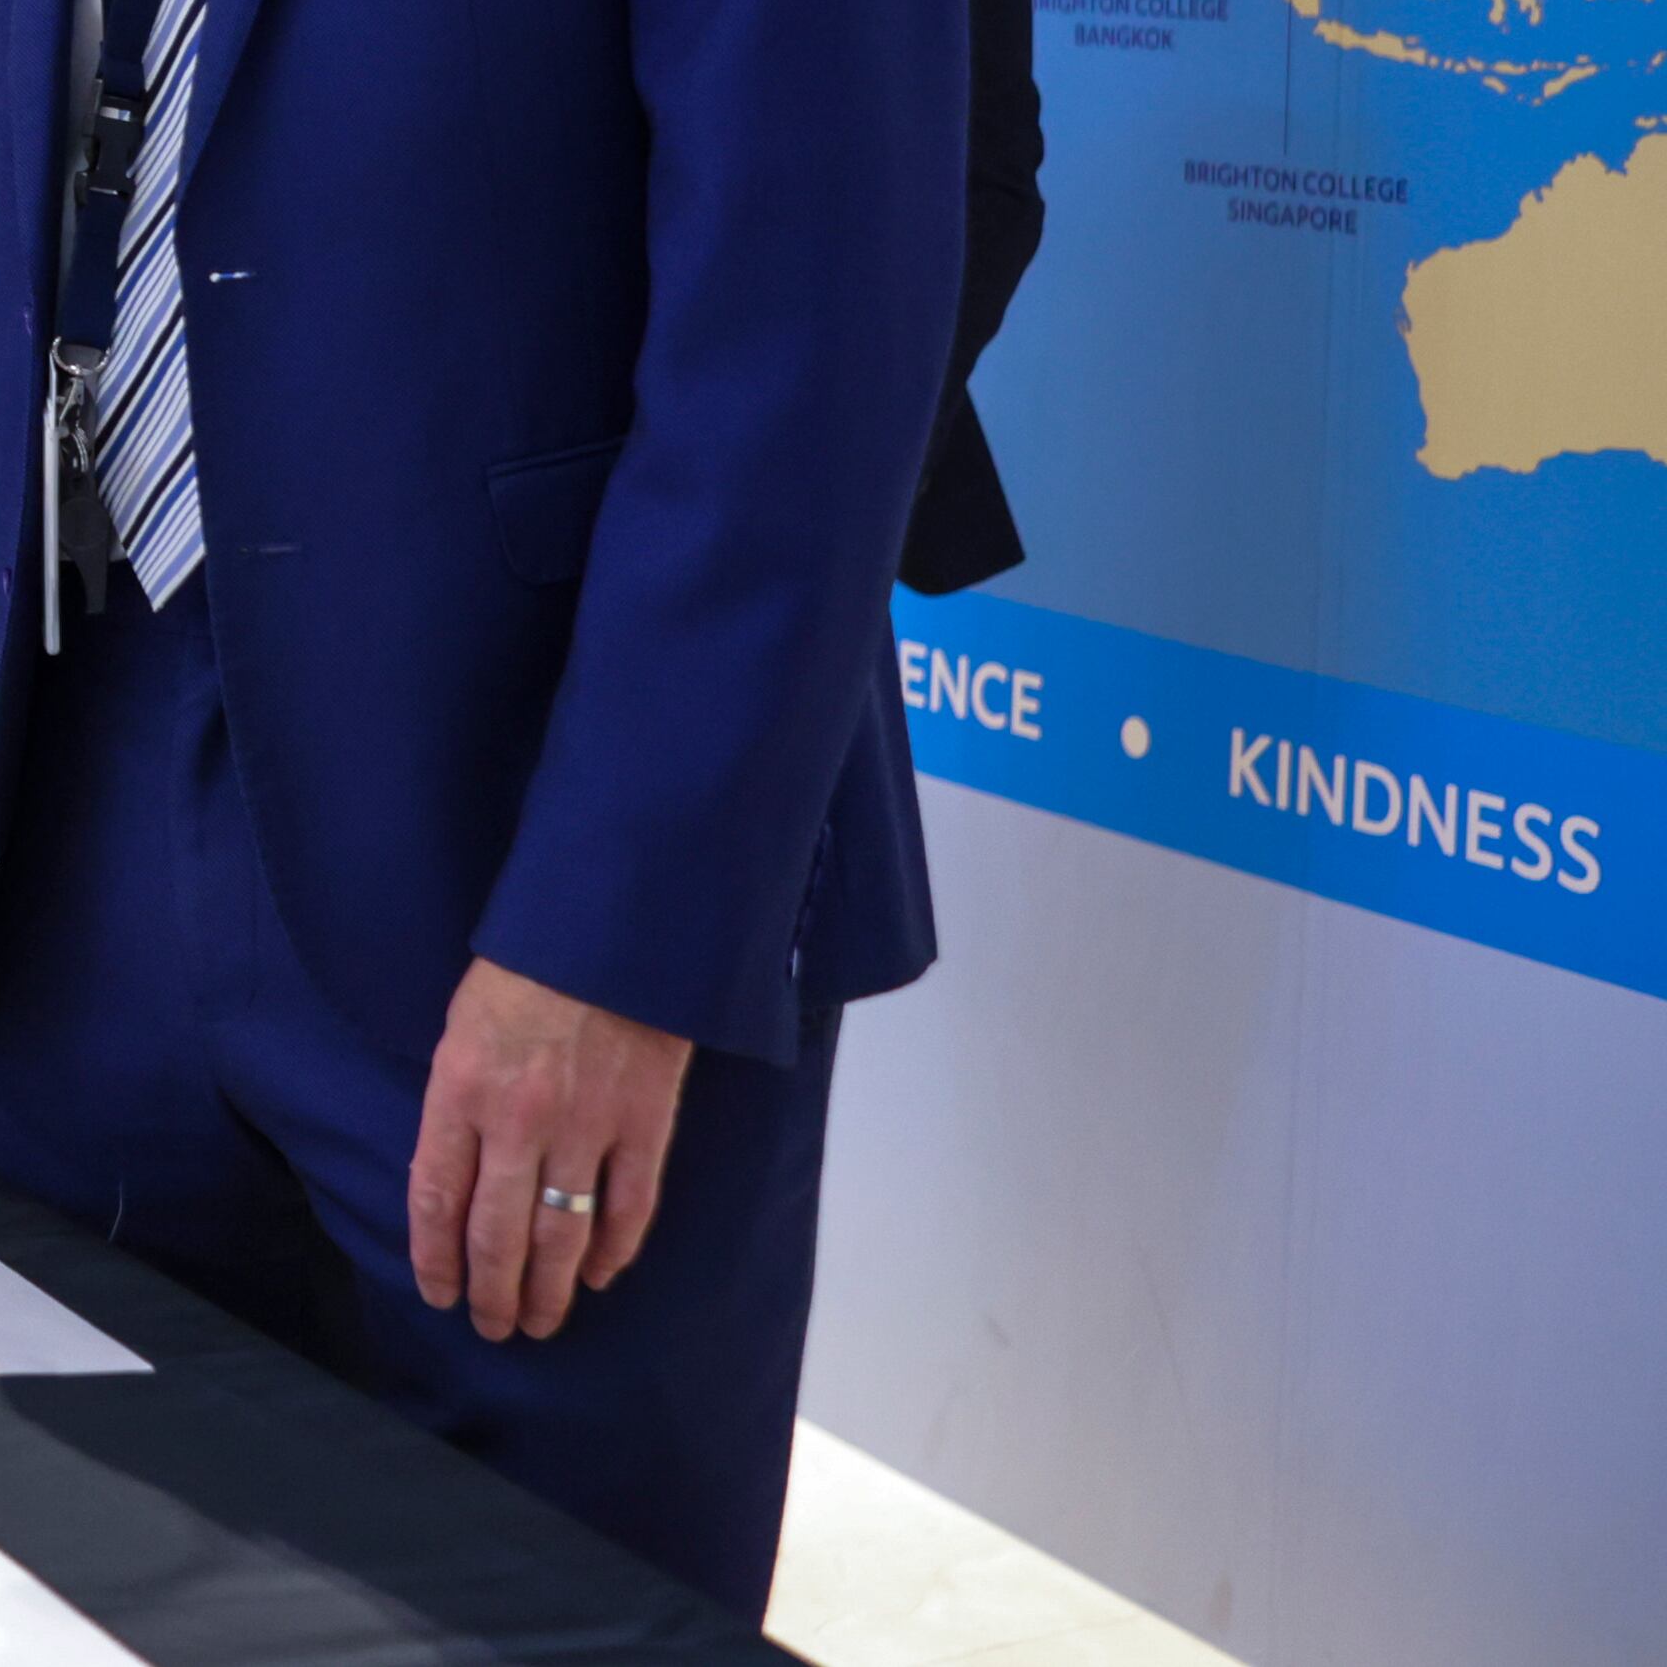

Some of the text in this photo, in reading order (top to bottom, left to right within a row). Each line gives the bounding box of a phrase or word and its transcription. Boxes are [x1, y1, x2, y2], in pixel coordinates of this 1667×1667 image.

[1074, 22, 1173, 50] BANGKOK
[1184, 159, 1409, 204] BRIGHTON COLLEGE
[1227, 196, 1358, 235] SINGAPORE
[899, 637, 1602, 895] ENCE KINDNESS
